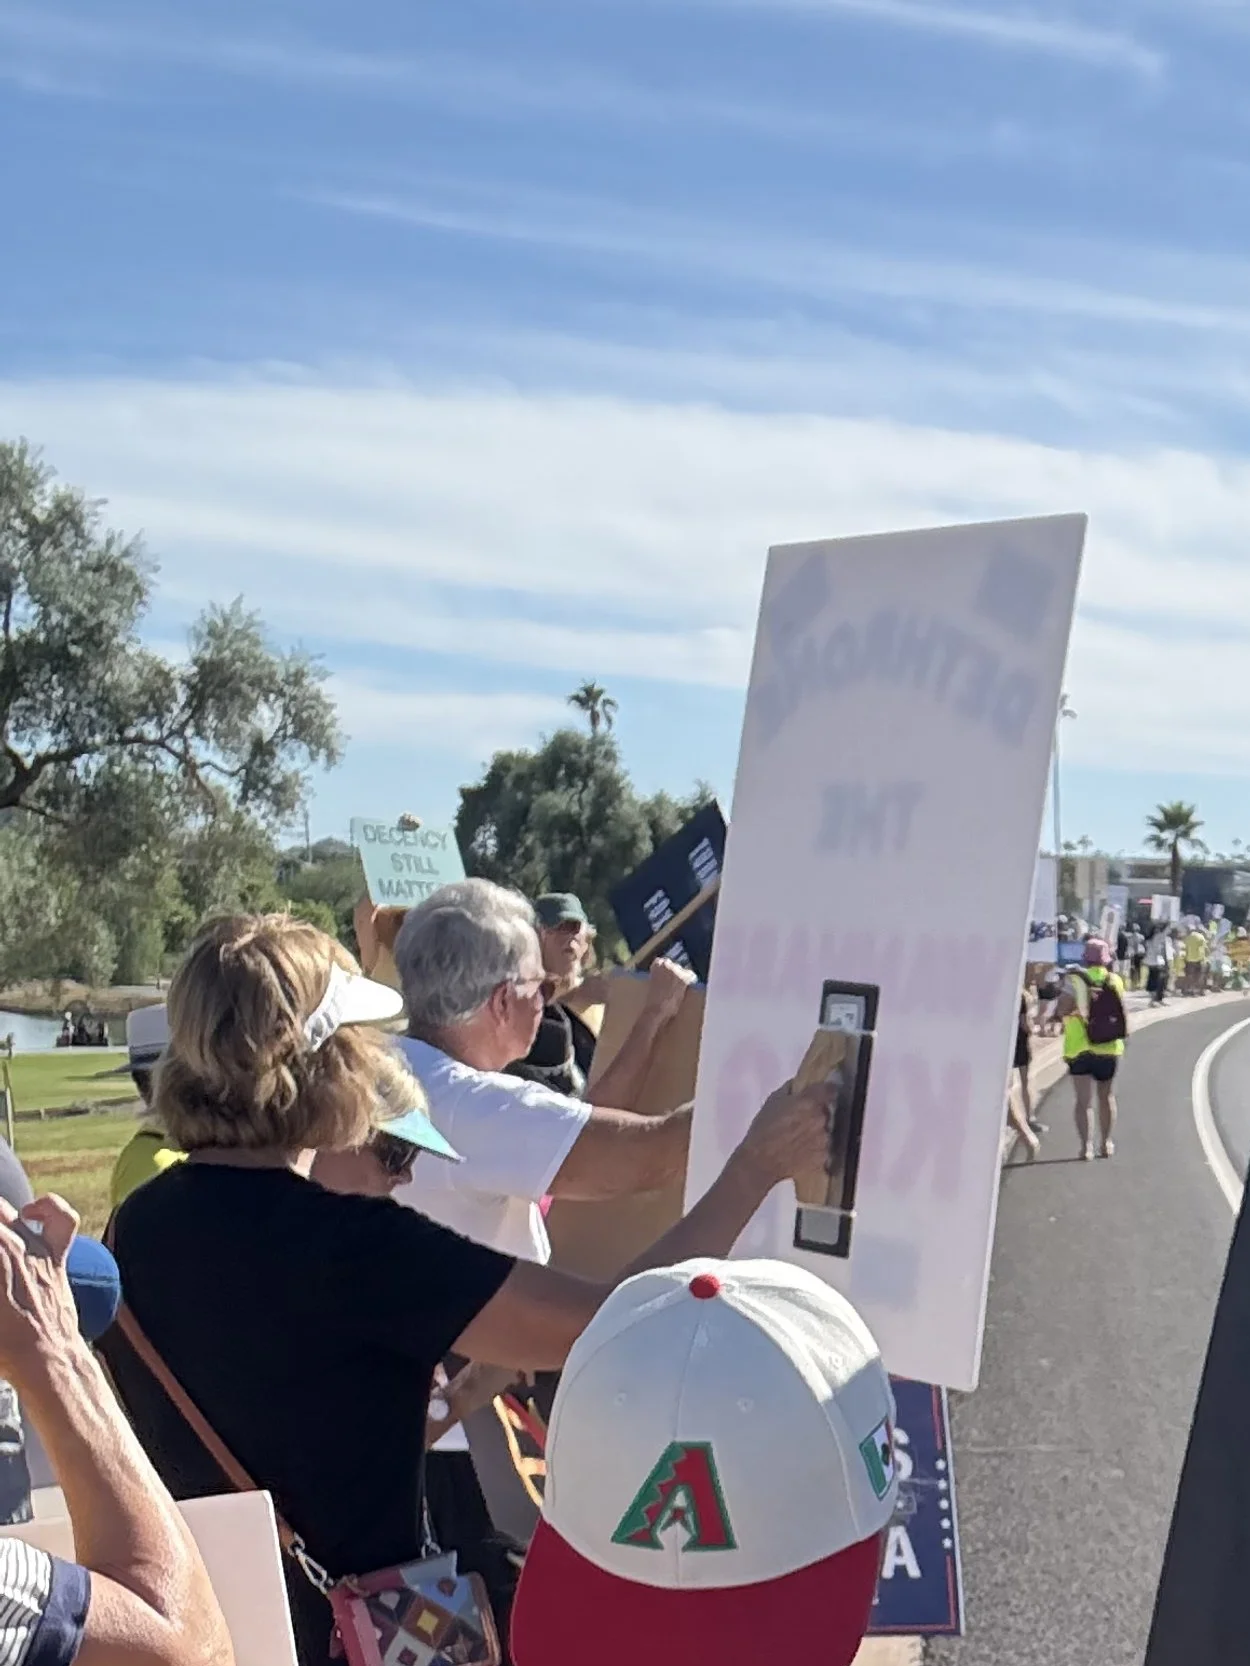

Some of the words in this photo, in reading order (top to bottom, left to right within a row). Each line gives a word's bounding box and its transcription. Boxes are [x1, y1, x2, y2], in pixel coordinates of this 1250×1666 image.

[363, 824, 447, 850] DECENCY
[391, 852, 440, 875] STILL
[378, 878, 435, 898] MATTE
